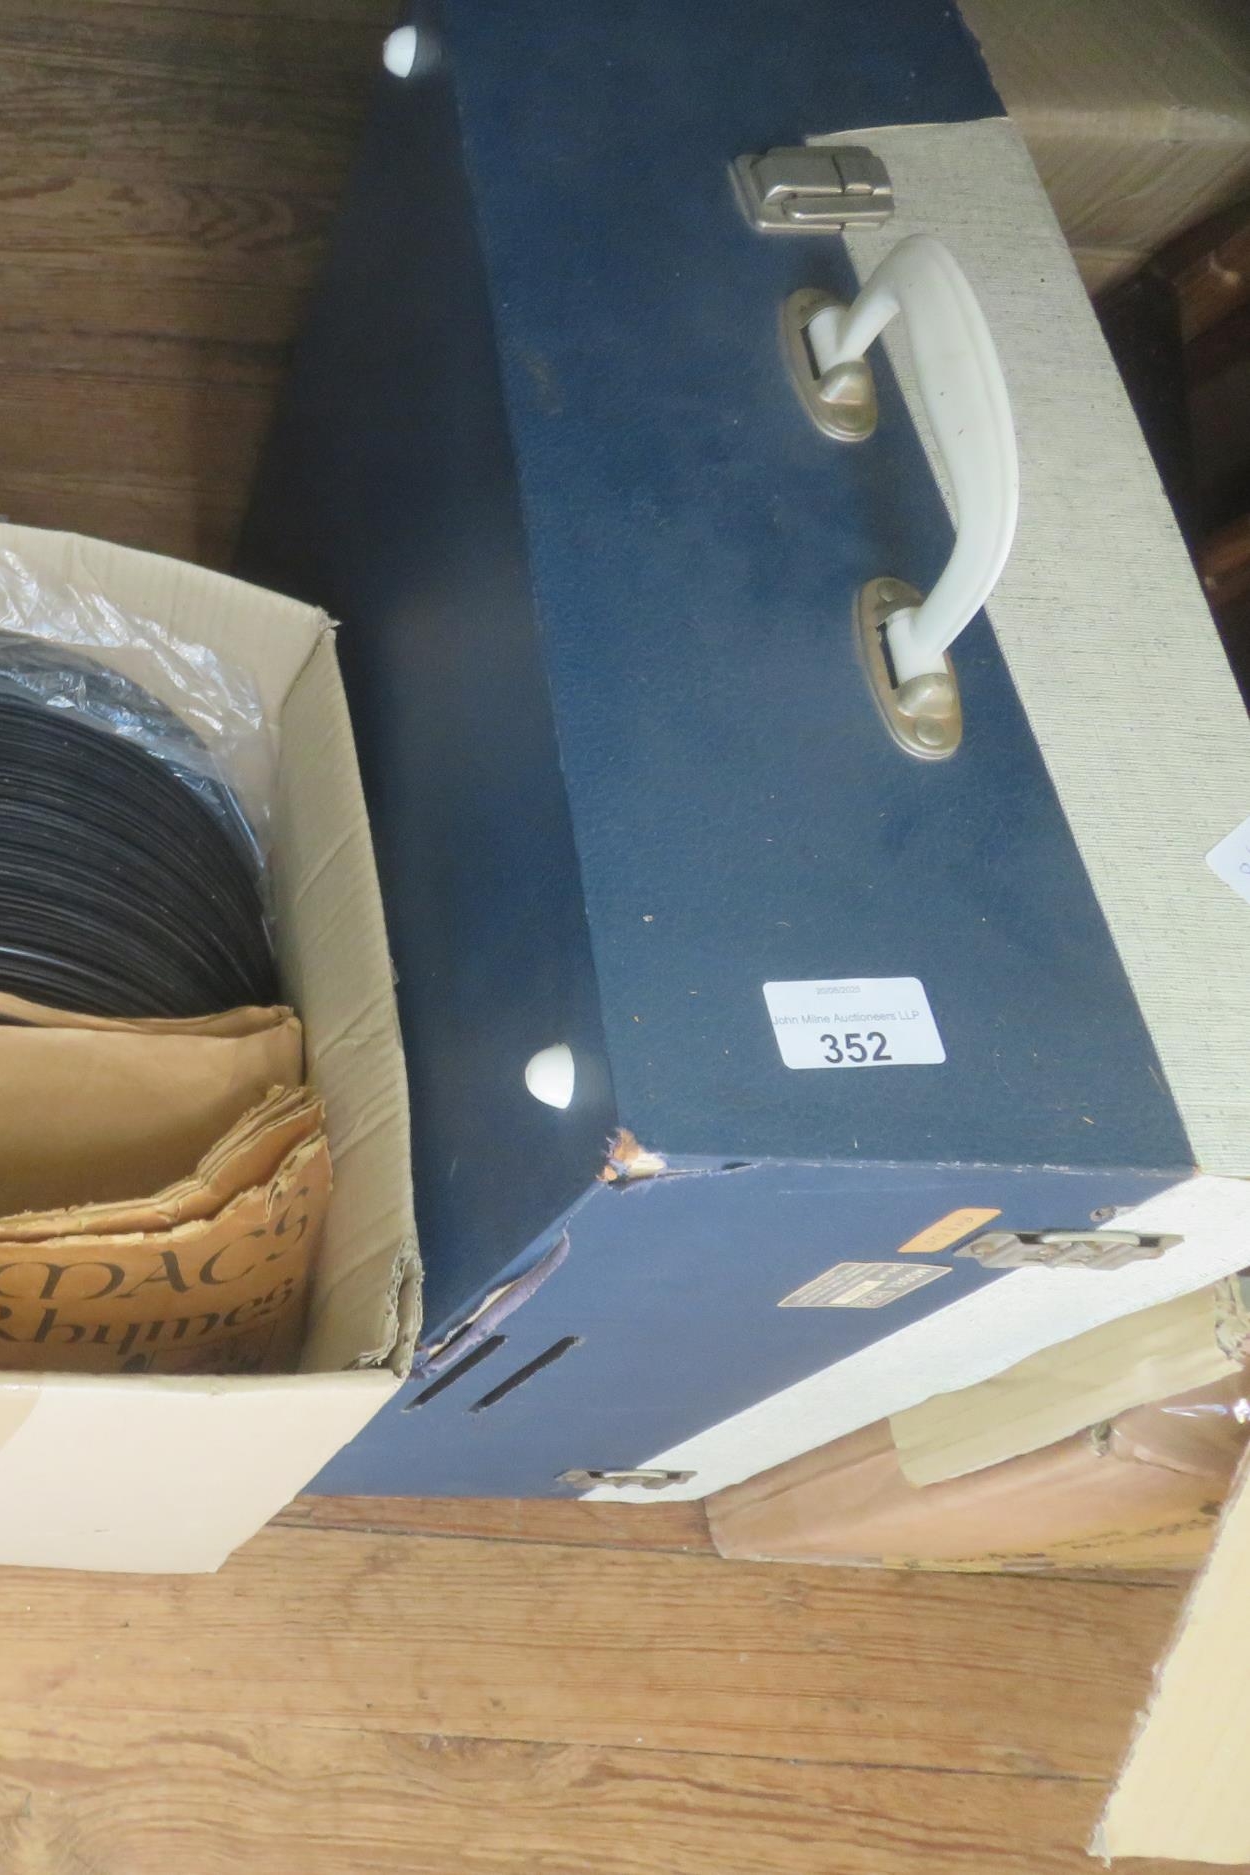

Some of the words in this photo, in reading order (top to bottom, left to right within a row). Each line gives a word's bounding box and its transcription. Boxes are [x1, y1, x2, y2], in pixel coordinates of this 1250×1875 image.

[772, 1014, 799, 1026] John
[802, 1013, 830, 1025] Milne
[834, 1011, 897, 1024] Auctioneers
[899, 1010, 920, 1022] LLP
[819, 1031, 892, 1064] 352
